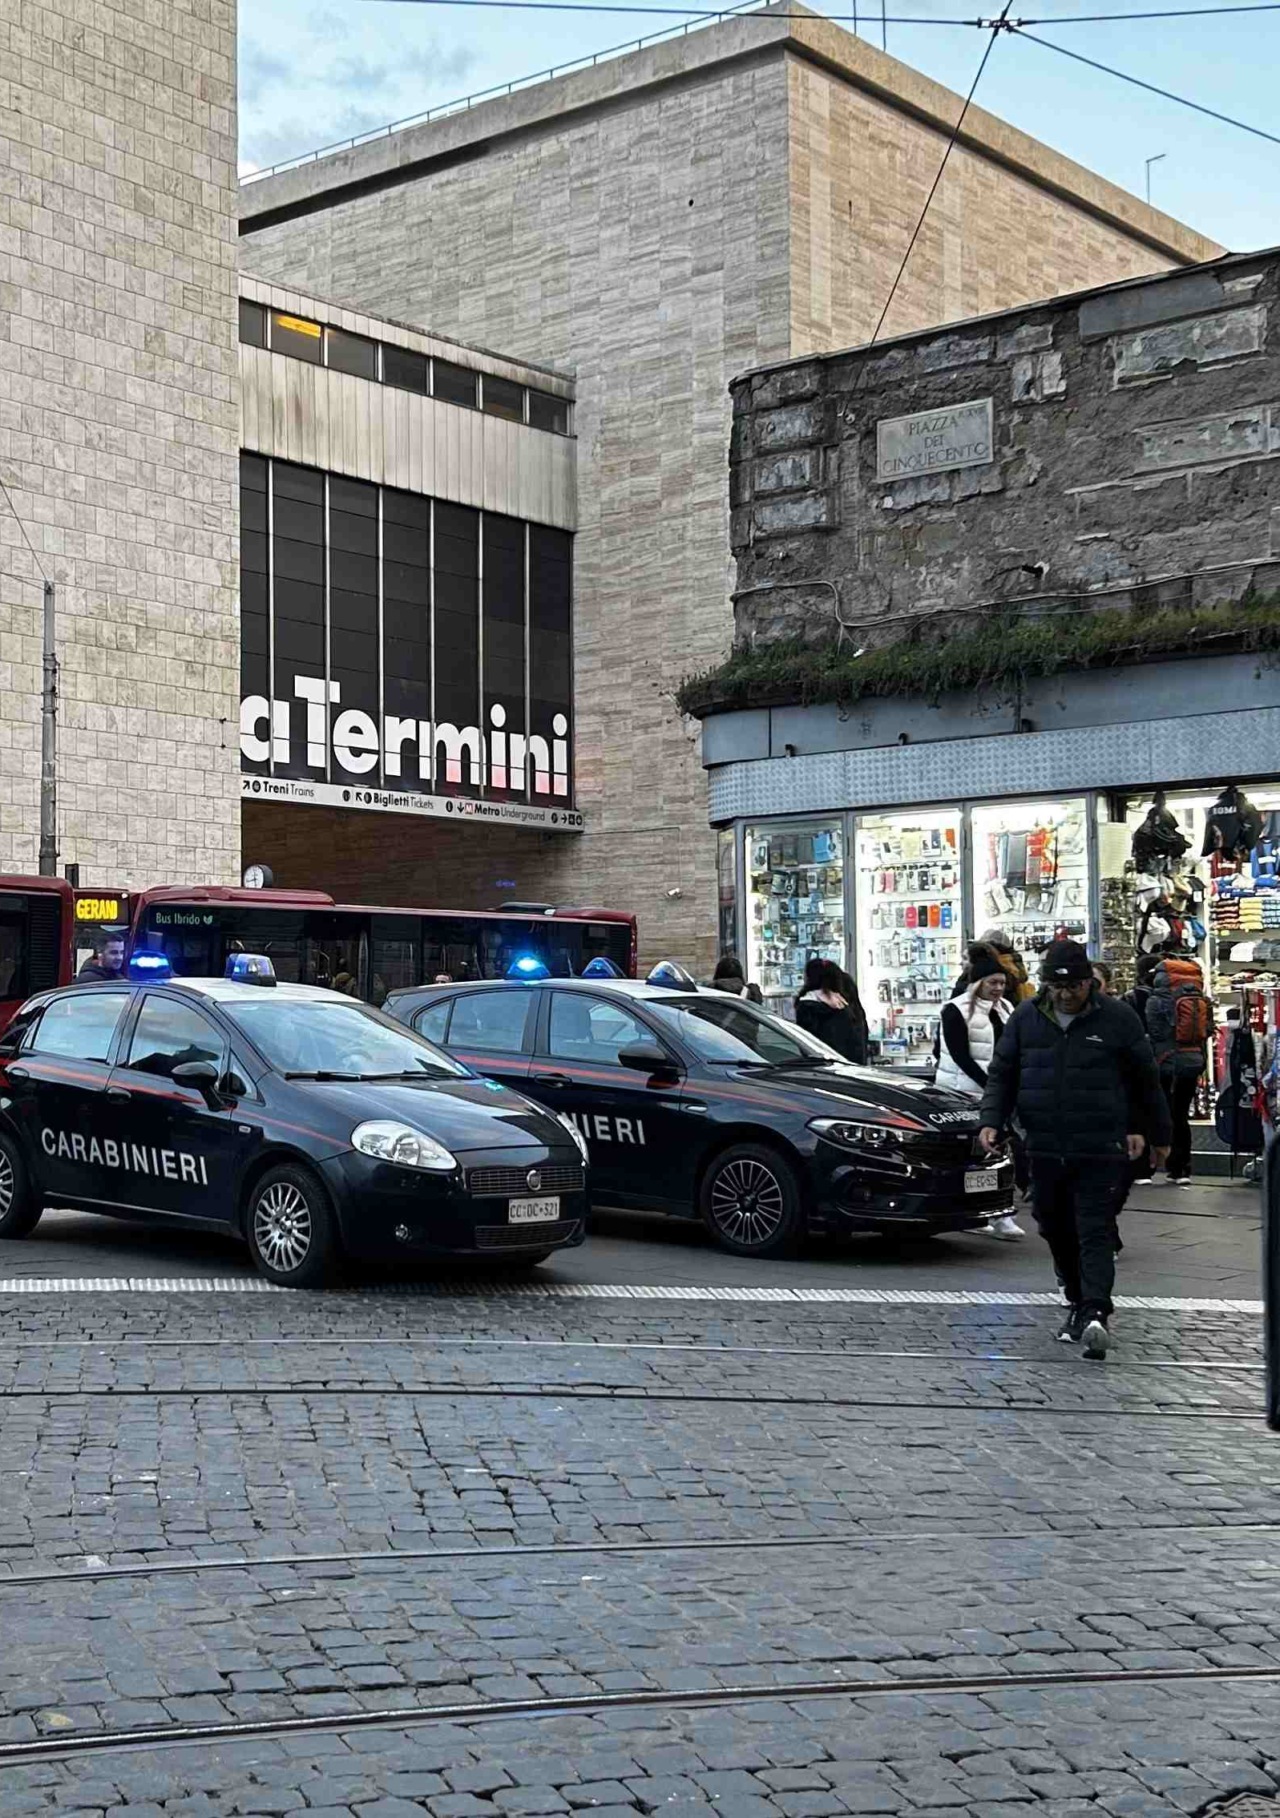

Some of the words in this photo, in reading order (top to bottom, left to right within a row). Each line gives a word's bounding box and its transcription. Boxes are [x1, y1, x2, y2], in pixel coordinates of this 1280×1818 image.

[909, 416, 958, 435] PIAZZA
[924, 435, 944, 448] DEI
[883, 442, 988, 472] CINQUECENTO
[263, 781, 289, 794] Treni
[290, 784, 315, 797] Trains
[374, 793, 409, 807] Biglietti
[410, 797, 434, 809] Tickets
[474, 804, 500, 816] Metro
[501, 809, 545, 821] Underground
[156, 912, 171, 924] Bus
[174, 913, 200, 925] Ibrido
[41, 1127, 208, 1185] CARABINIERI
